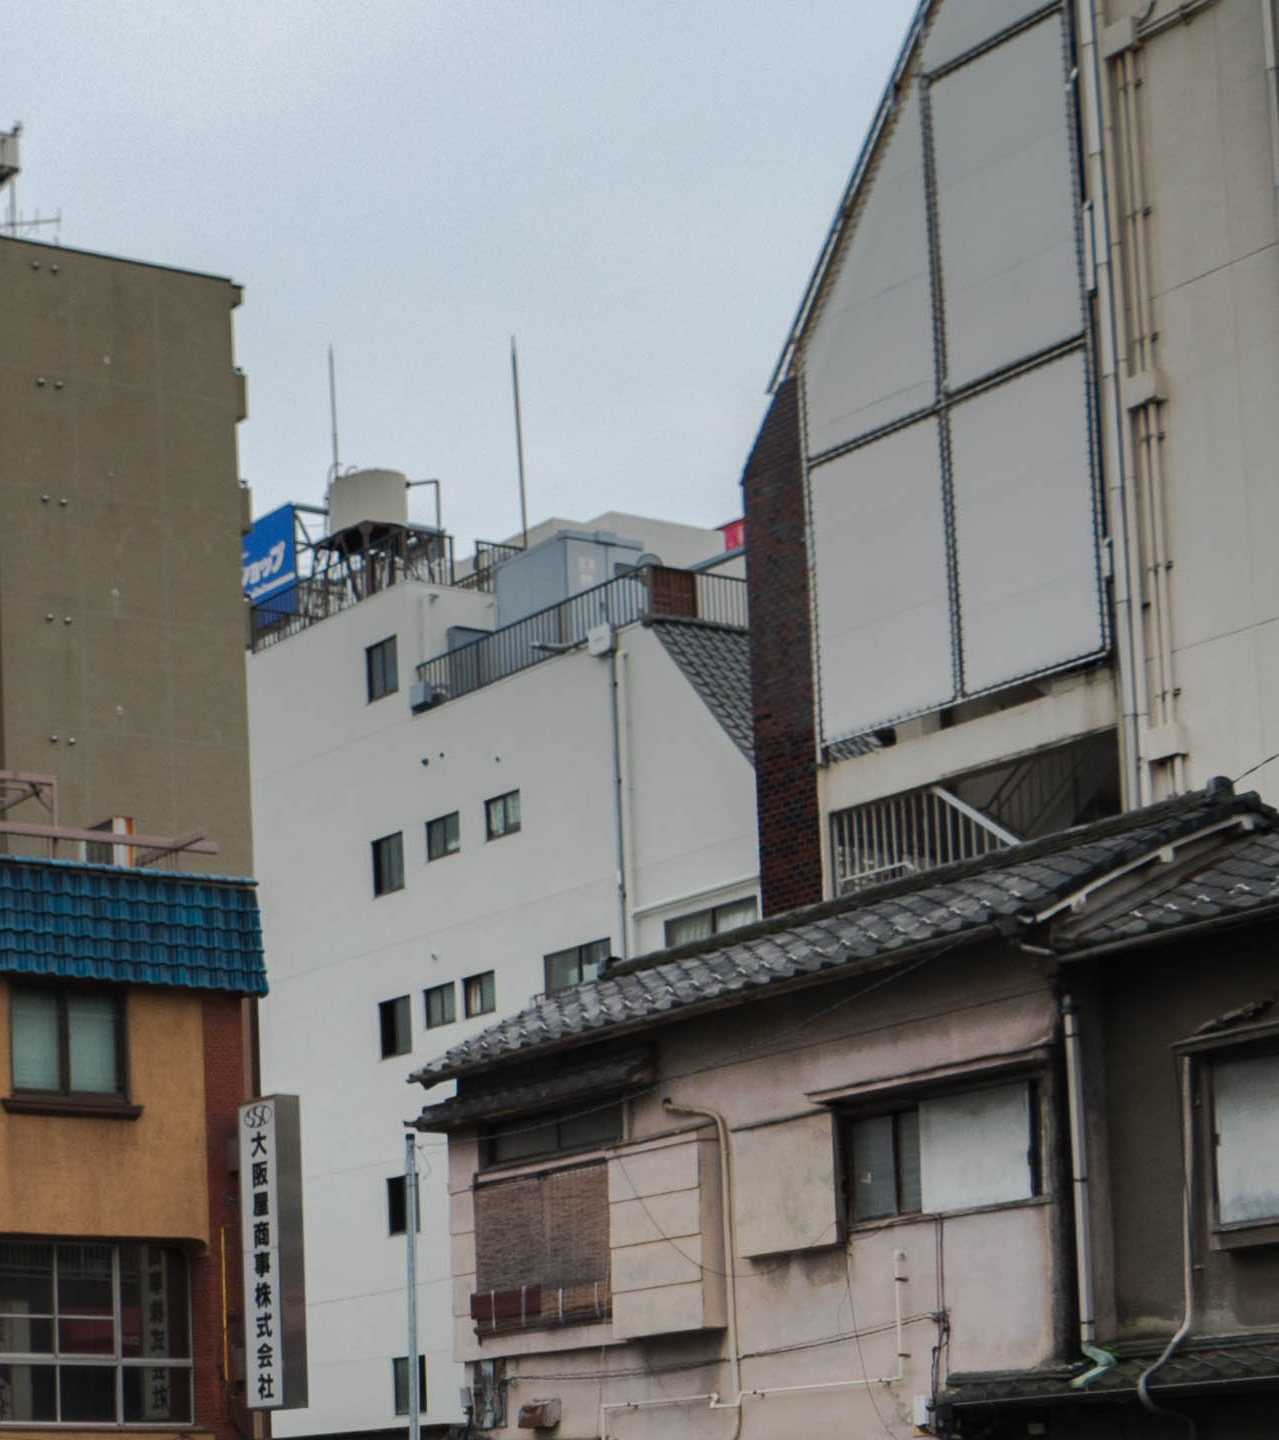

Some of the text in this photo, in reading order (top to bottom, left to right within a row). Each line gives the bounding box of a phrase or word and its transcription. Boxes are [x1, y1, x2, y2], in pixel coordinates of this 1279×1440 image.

[250, 1131, 275, 1400] 大阪屋商事株式会社
